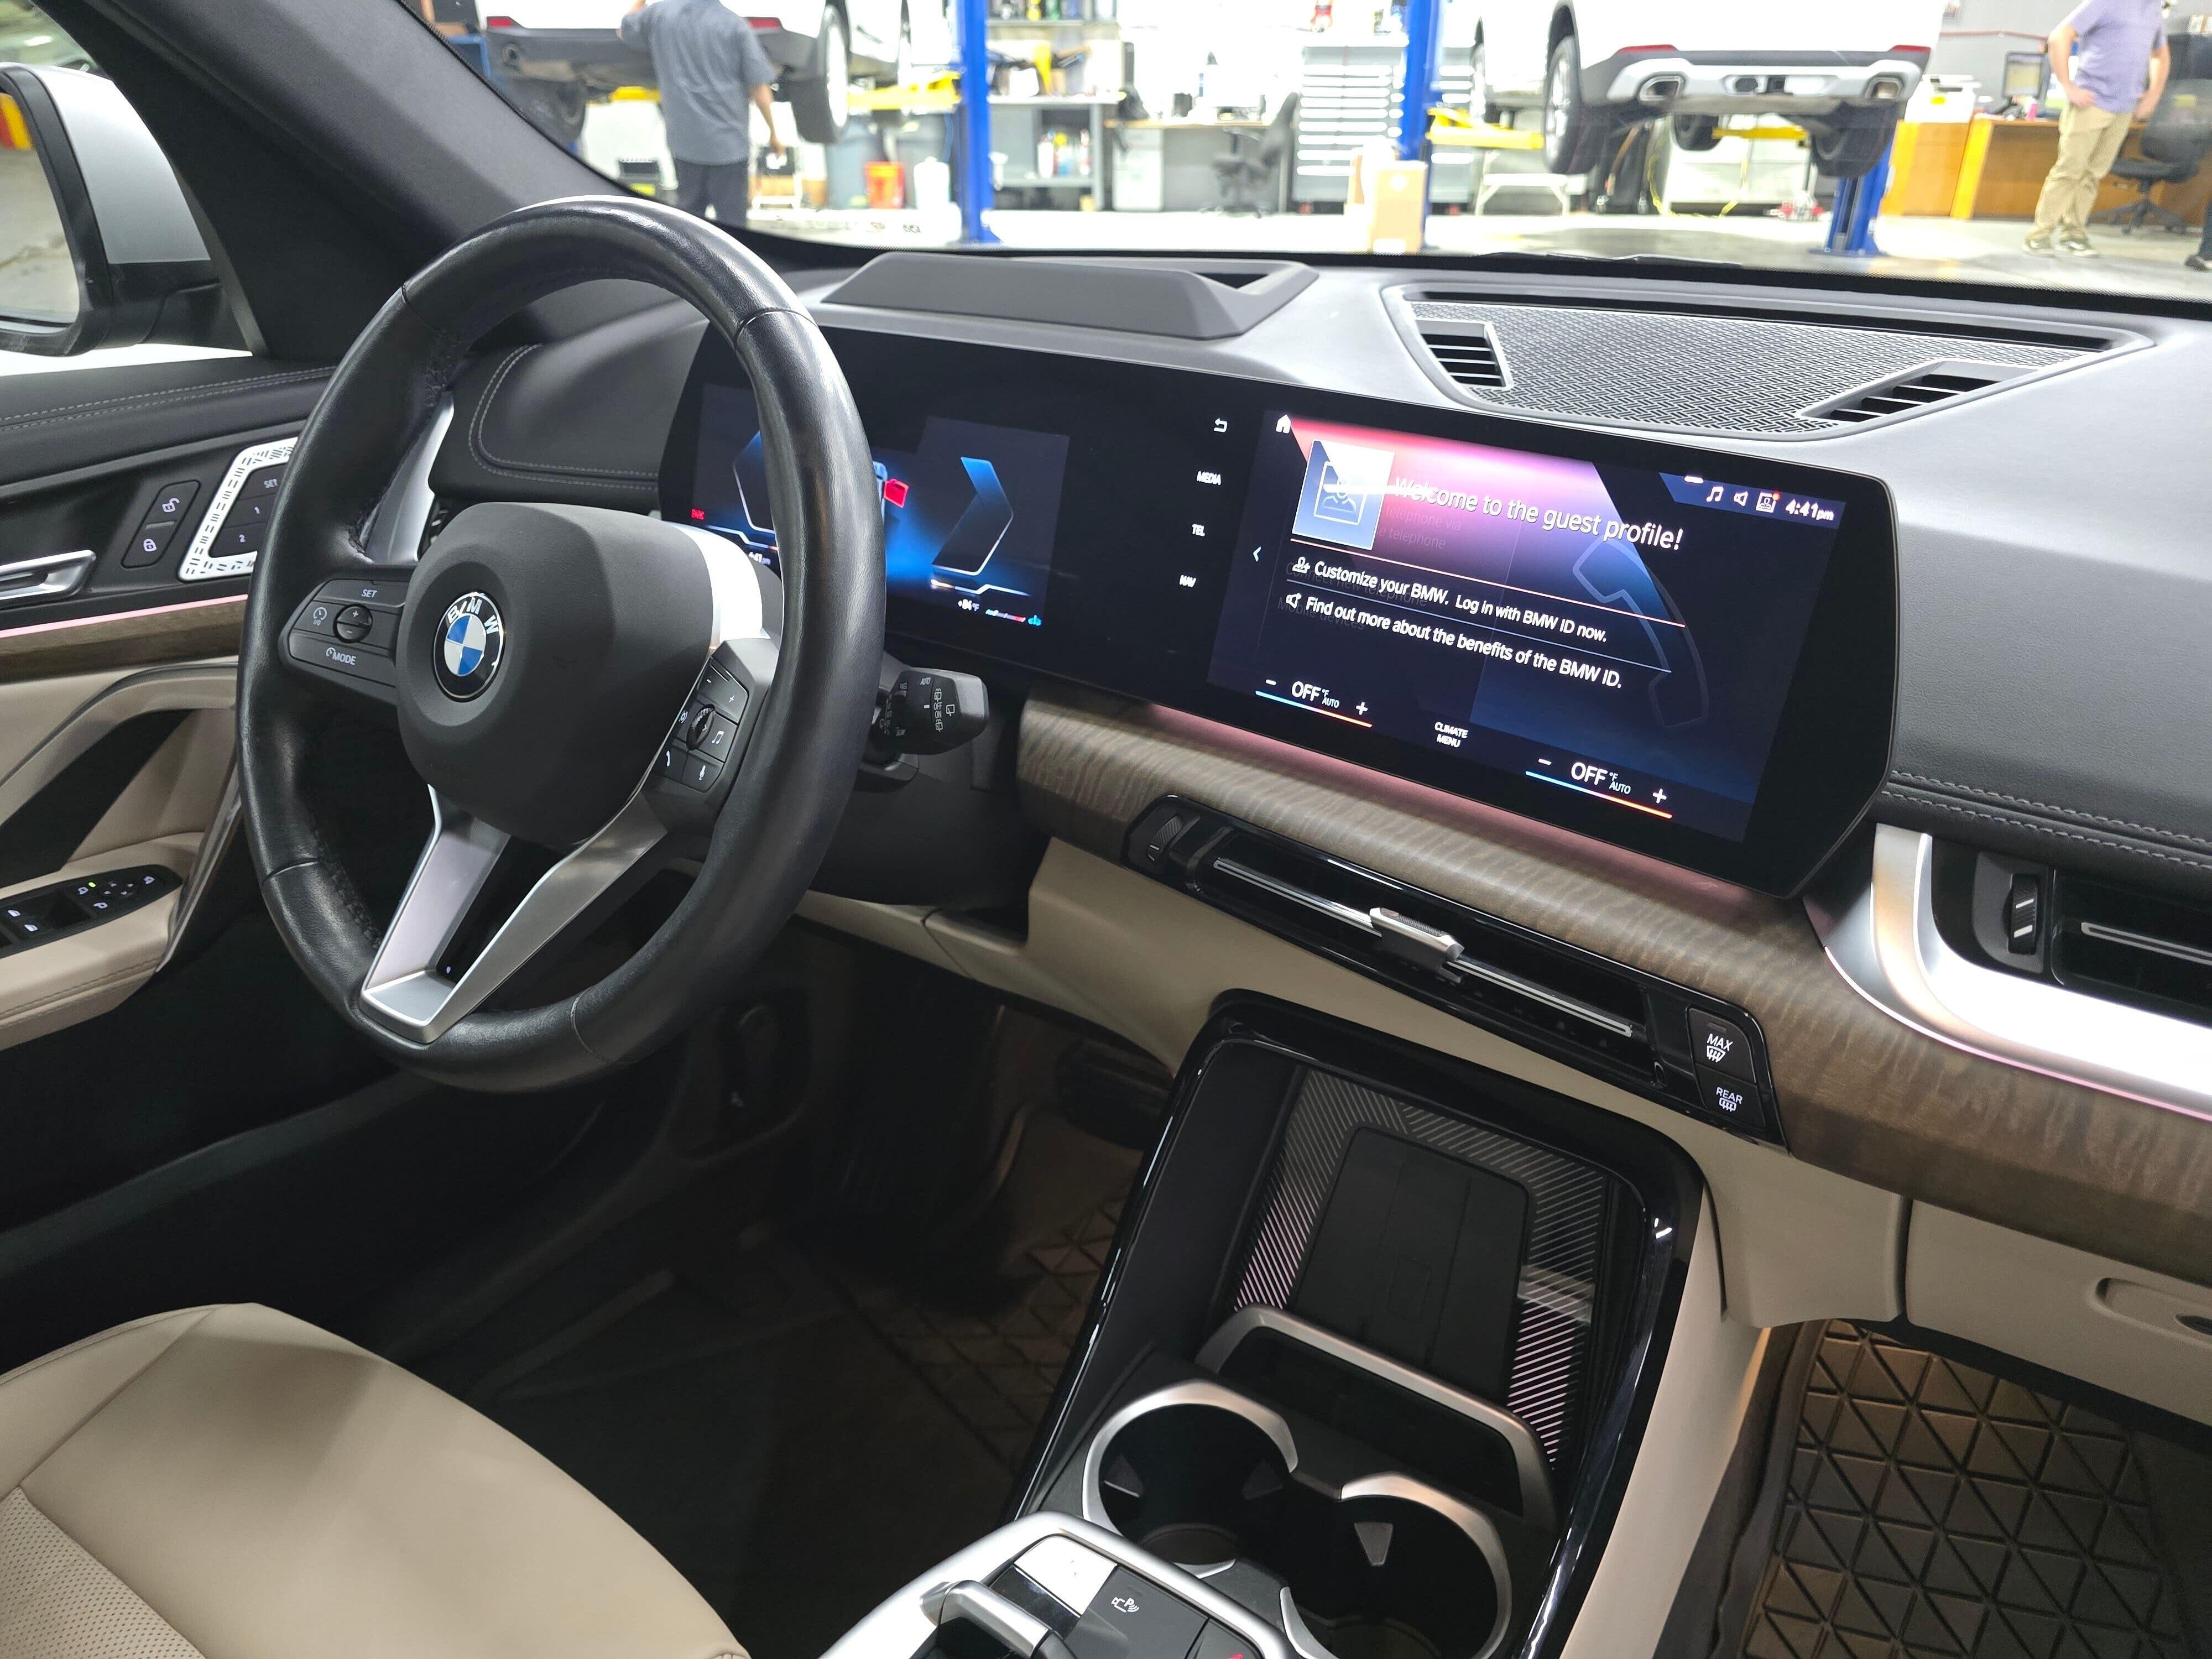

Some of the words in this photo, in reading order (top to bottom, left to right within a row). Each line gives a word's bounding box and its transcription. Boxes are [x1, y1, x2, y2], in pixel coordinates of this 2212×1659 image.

[1197, 471, 1221, 486] MEDIA
[1395, 478, 1478, 511] Welcome
[1483, 494, 1503, 516] to
[1507, 500, 1539, 523] the
[1542, 509, 1601, 536] guest
[1603, 520, 1683, 550] profile!
[1785, 499, 1834, 521] 4:41pm
[239, 534, 246, 542] 2
[1192, 524, 1205, 536] TEL
[361, 589, 378, 598] SET
[1314, 561, 1378, 589] Customize
[1379, 578, 1410, 595] your
[1411, 583, 1449, 606] BMW.
[1455, 594, 1480, 614] Log
[1481, 601, 1494, 615] in
[1495, 606, 1521, 622] with
[1523, 610, 1559, 630] BMW
[1559, 618, 1575, 634] ID
[1577, 625, 1606, 642] now.
[447, 597, 499, 634] BMW
[1306, 596, 1332, 616] Find
[1334, 606, 1357, 622] out
[1357, 611, 1391, 630] more
[1392, 619, 1432, 640] about
[1433, 627, 1455, 646] the
[1457, 633, 1514, 660] benefits
[1515, 649, 1533, 665] of
[1533, 653, 1557, 671] the
[1559, 659, 1601, 682] BMW
[1601, 670, 1622, 688] ID.
[332, 651, 357, 665] MODE
[1291, 681, 1322, 701] OFF
[1322, 697, 1339, 708] AUTO
[1434, 722, 1469, 739] CLIMATE
[1437, 734, 1460, 748] MENU
[1571, 762, 1608, 785] OFF
[1609, 781, 1631, 795] AUTO
[1707, 1033, 1734, 1051] MAX
[1716, 1087, 1743, 1104] REAR
